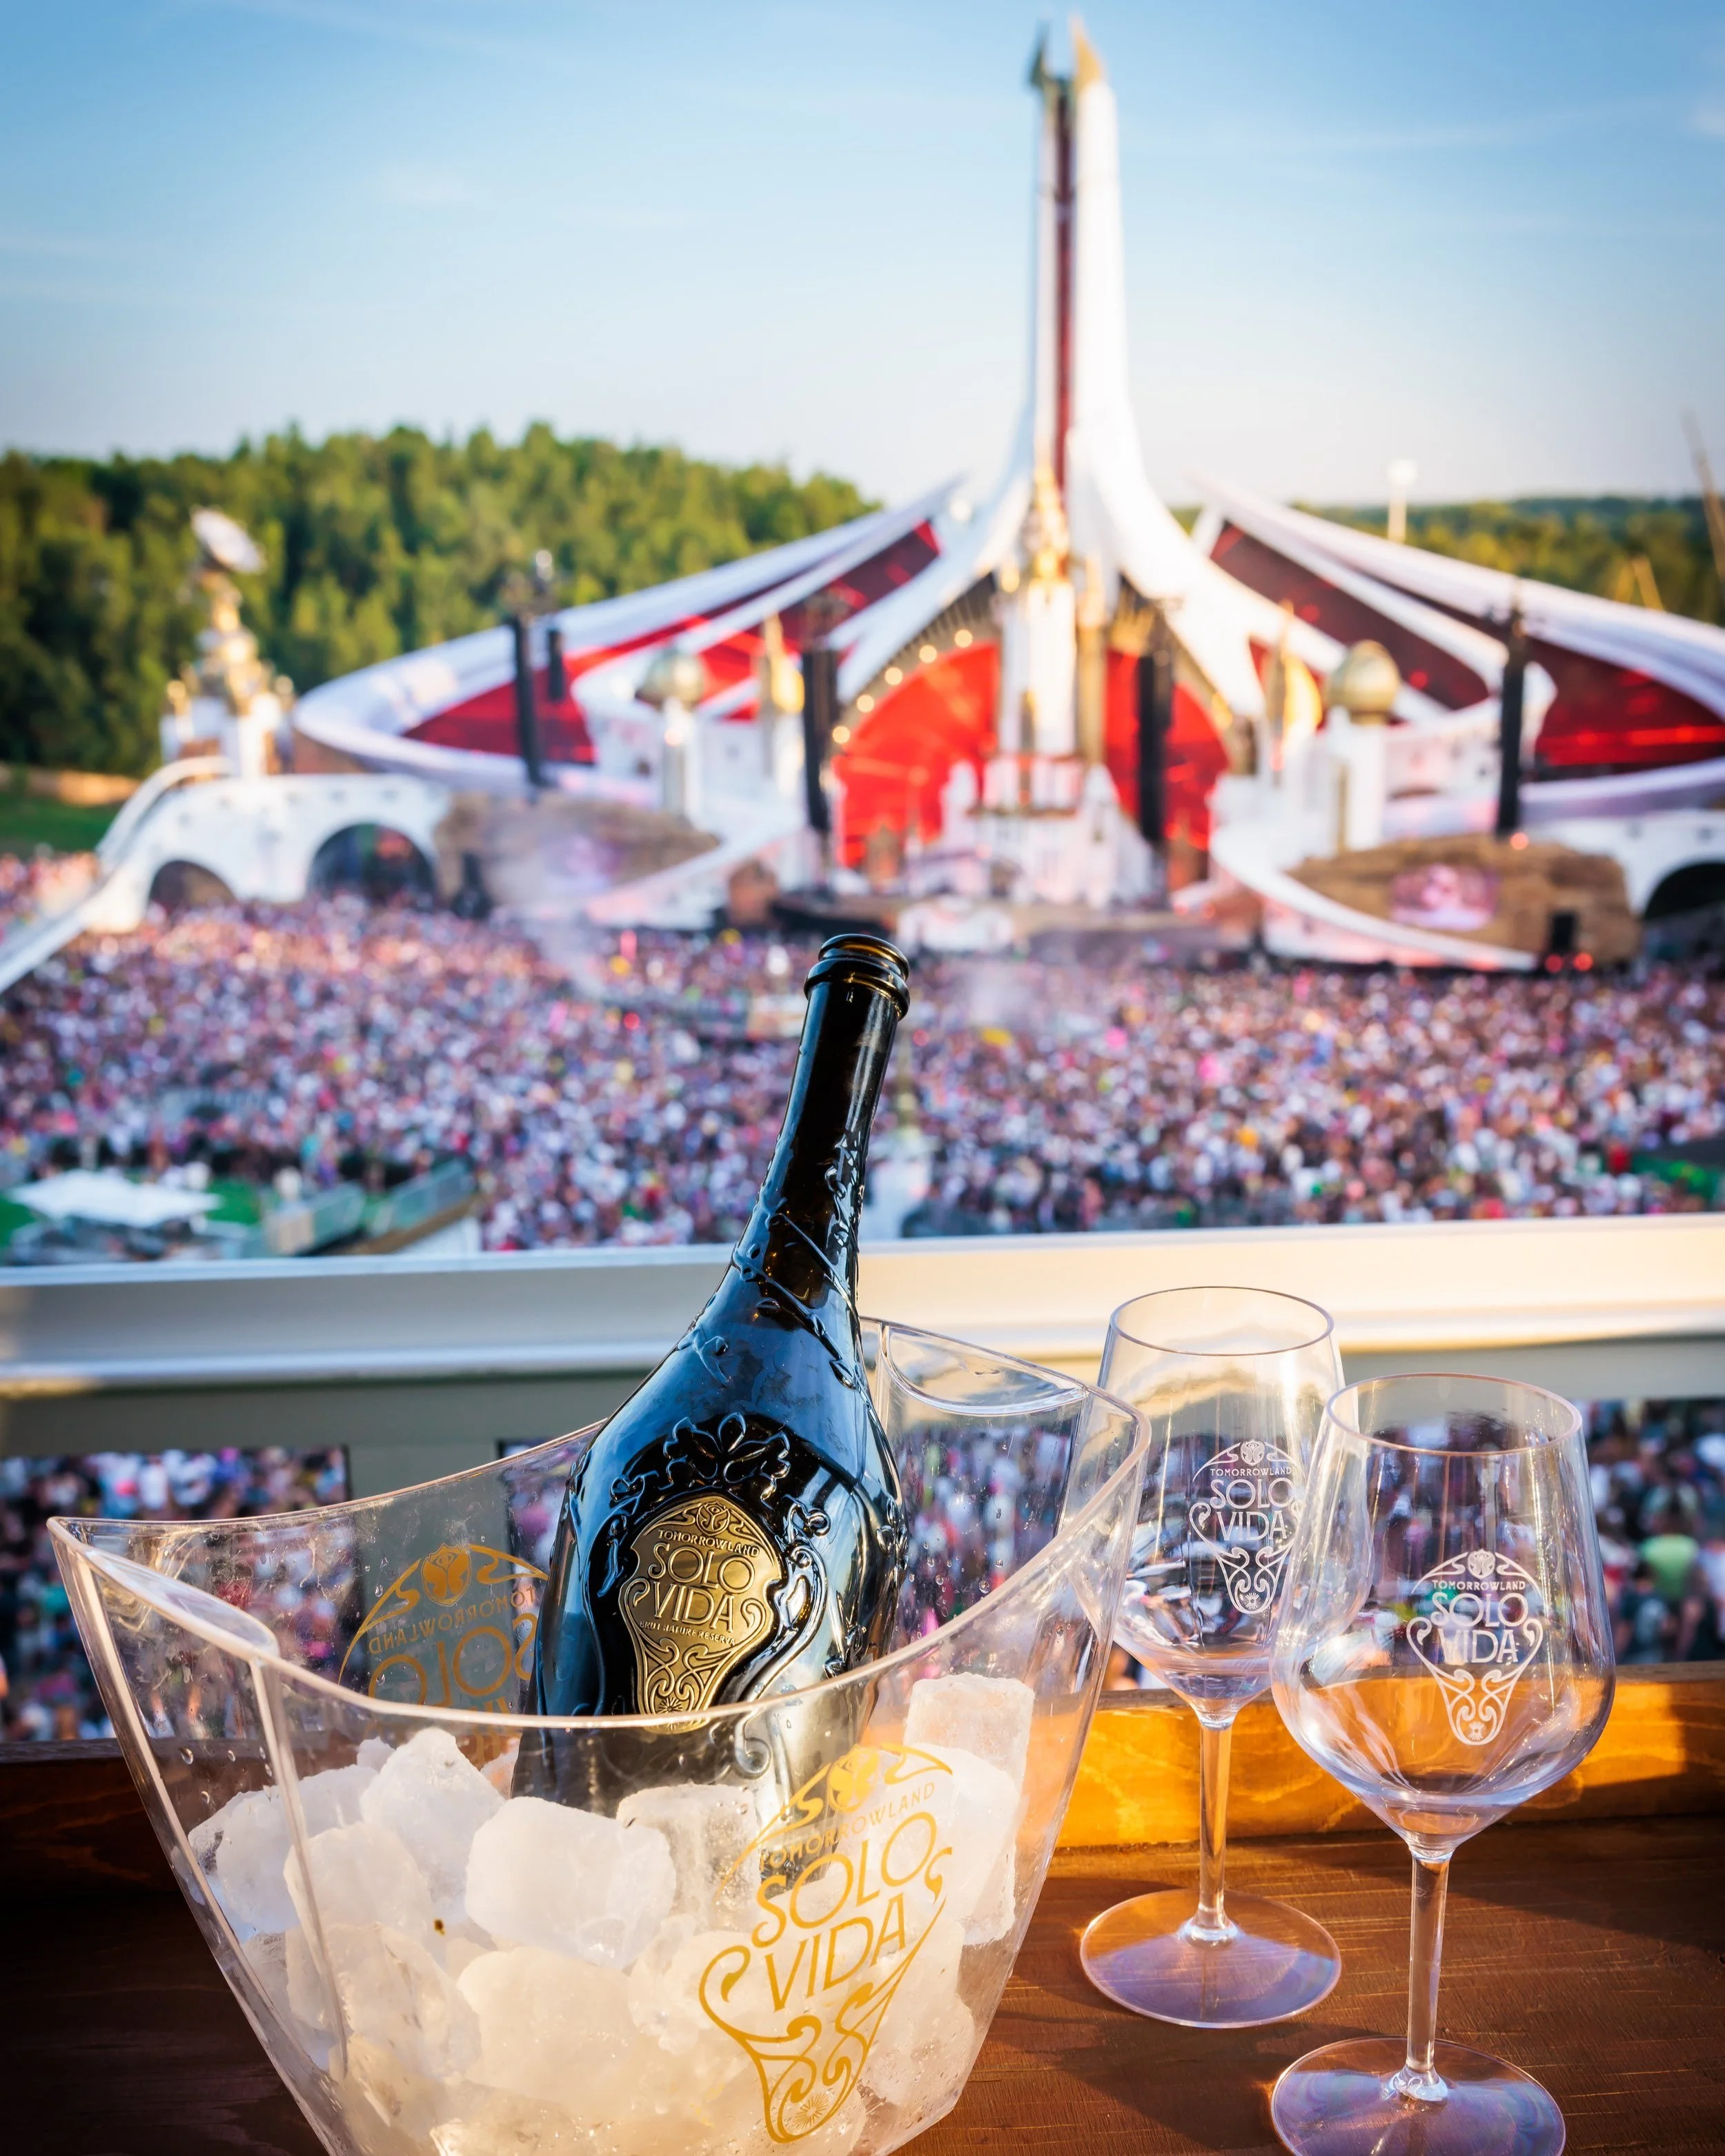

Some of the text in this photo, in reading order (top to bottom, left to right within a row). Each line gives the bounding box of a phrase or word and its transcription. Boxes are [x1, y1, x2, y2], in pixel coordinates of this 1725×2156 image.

[1210, 1467, 1292, 1476] TOMORROWLAND
[1210, 1478, 1294, 1509] SOLO
[658, 1529, 760, 1557] TOMORROWLAND
[1216, 1510, 1288, 1541] VIDA
[648, 1542, 756, 1594] SOLO
[1432, 1580, 1526, 1591] TOMORROWLAND
[653, 1581, 735, 1633] VIDA
[1431, 1592, 1528, 1627] SOLO
[639, 1621, 736, 1646] BRUT NATURE RESERVA
[1438, 1628, 1519, 1663] VIDA
[759, 1783, 935, 1872] TOMORROWLAND
[751, 1812, 937, 1948] SOLO
[765, 1893, 906, 2012] VIDA
